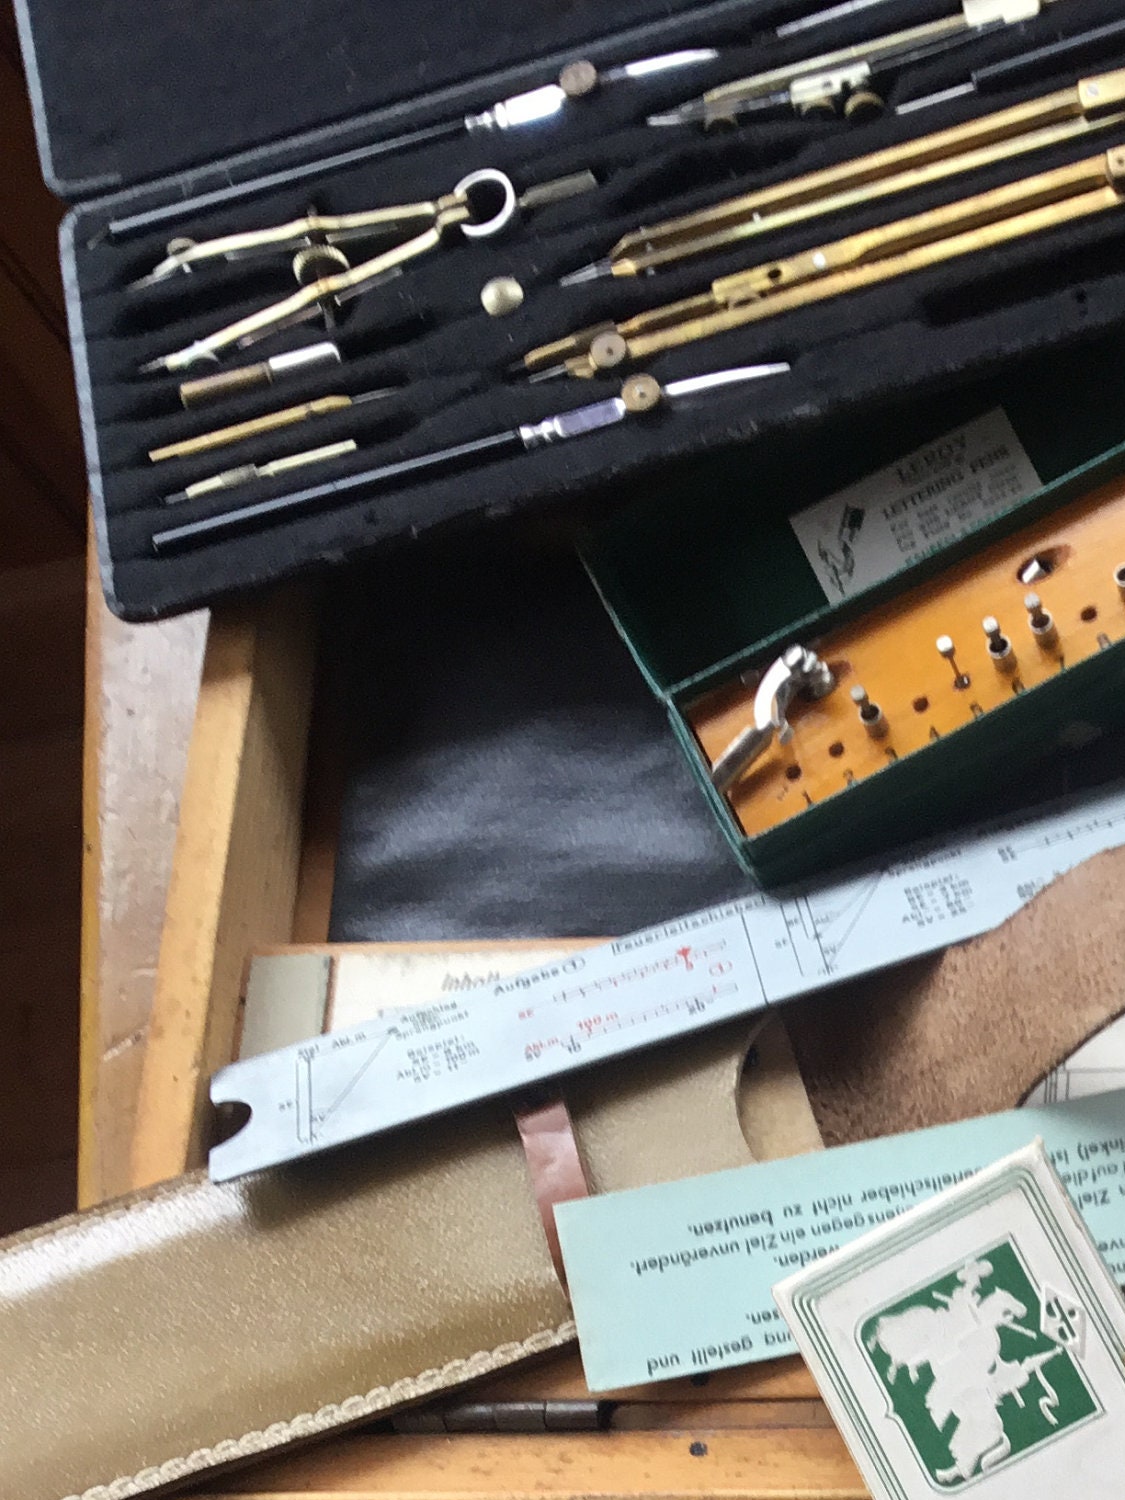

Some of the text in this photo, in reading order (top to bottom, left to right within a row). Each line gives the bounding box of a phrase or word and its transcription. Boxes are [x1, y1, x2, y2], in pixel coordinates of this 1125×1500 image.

[781, 1203, 802, 1219] zu
[809, 1193, 853, 1218] nicht
[687, 1207, 774, 1243] benutzen.
[778, 1225, 807, 1247] ein
[743, 1231, 779, 1254] Ziel
[688, 1333, 755, 1367] gestellt
[645, 1352, 682, 1376] und
